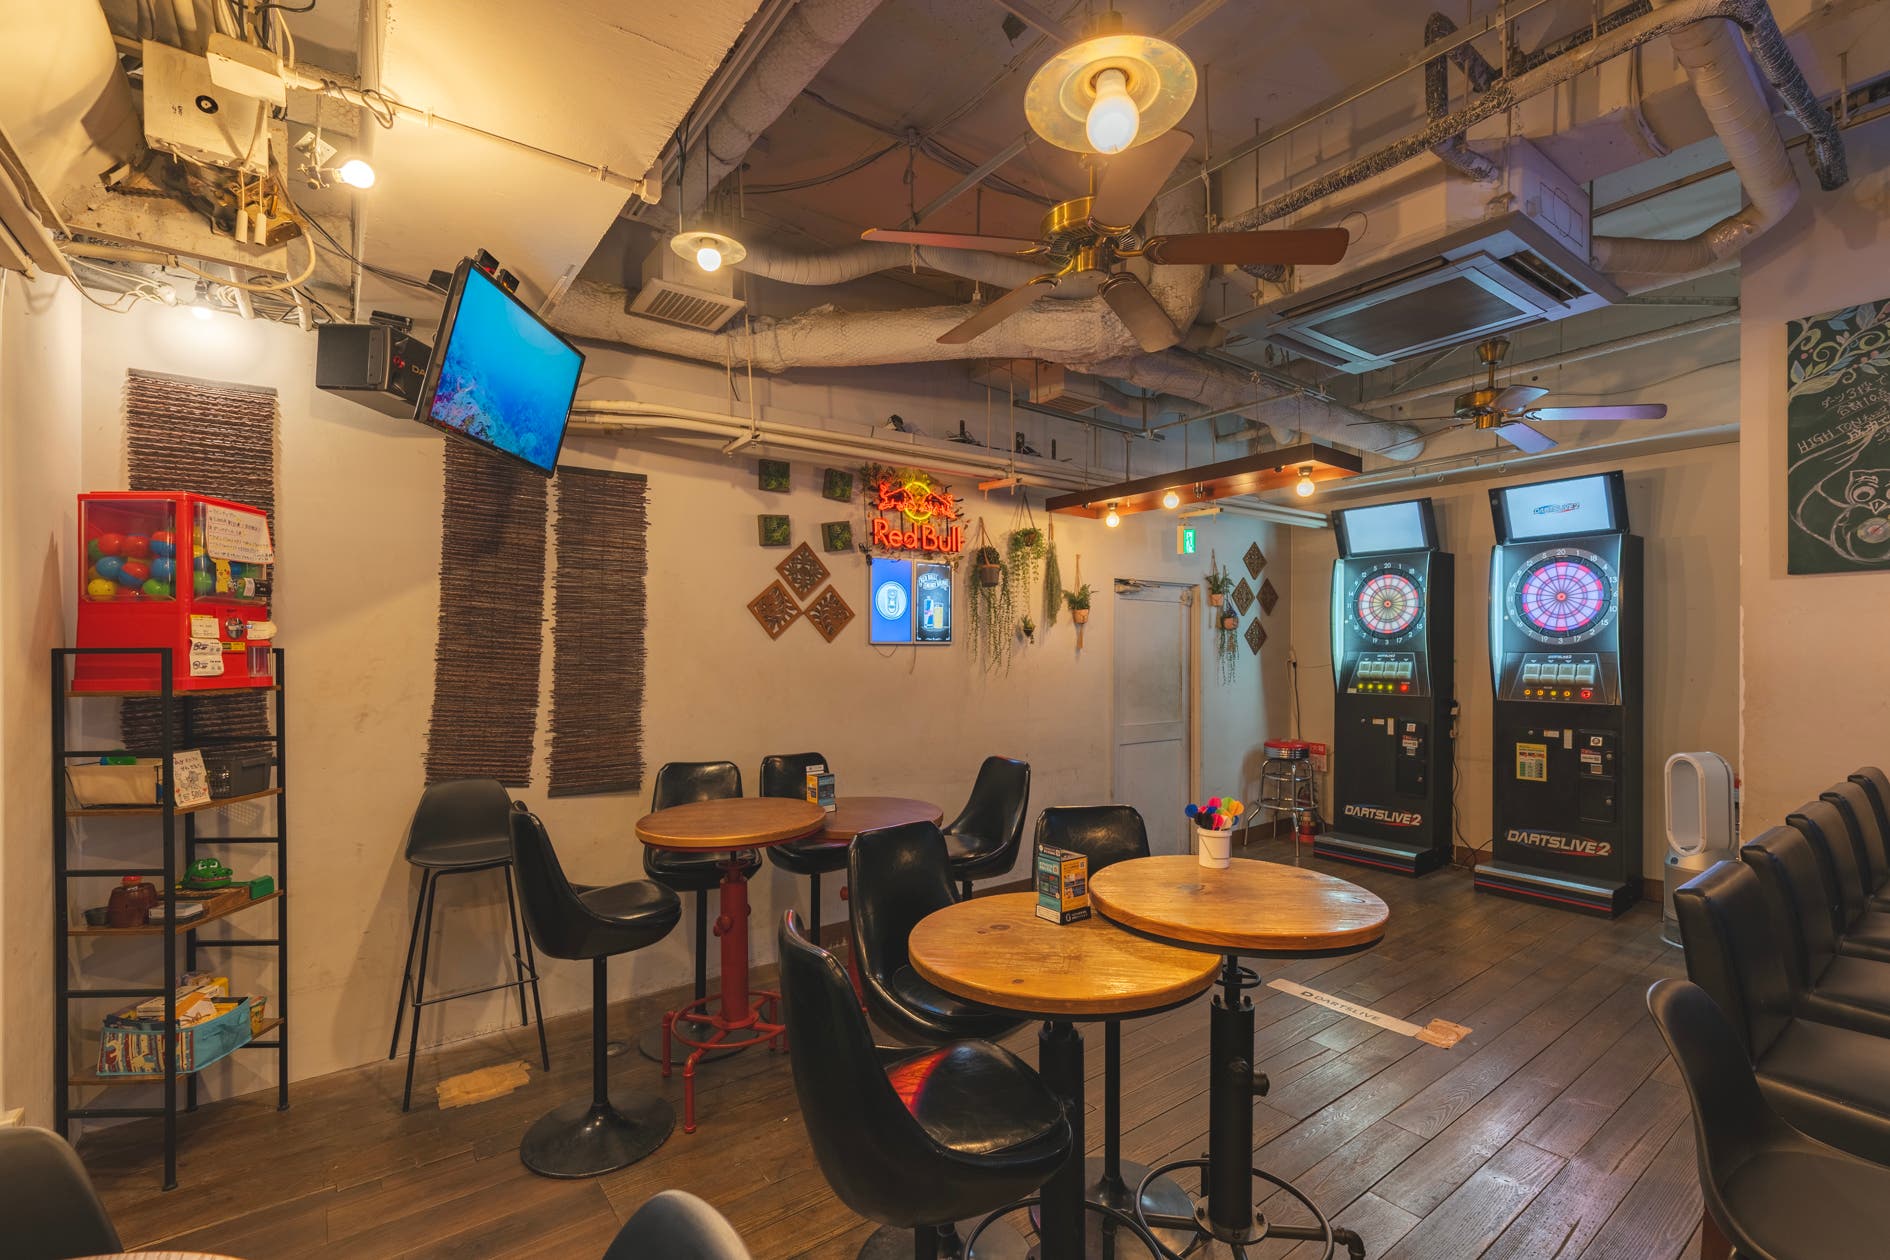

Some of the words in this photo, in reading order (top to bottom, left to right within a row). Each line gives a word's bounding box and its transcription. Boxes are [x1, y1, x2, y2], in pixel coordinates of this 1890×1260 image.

[1797, 429, 1835, 454] HIGH
[873, 518, 918, 549] Red
[921, 524, 962, 553] Bull
[1344, 804, 1422, 827] DARTSLIVE2
[1507, 829, 1612, 857] DARTSLIVE2
[1313, 995, 1381, 1022] DARTSLIVE
